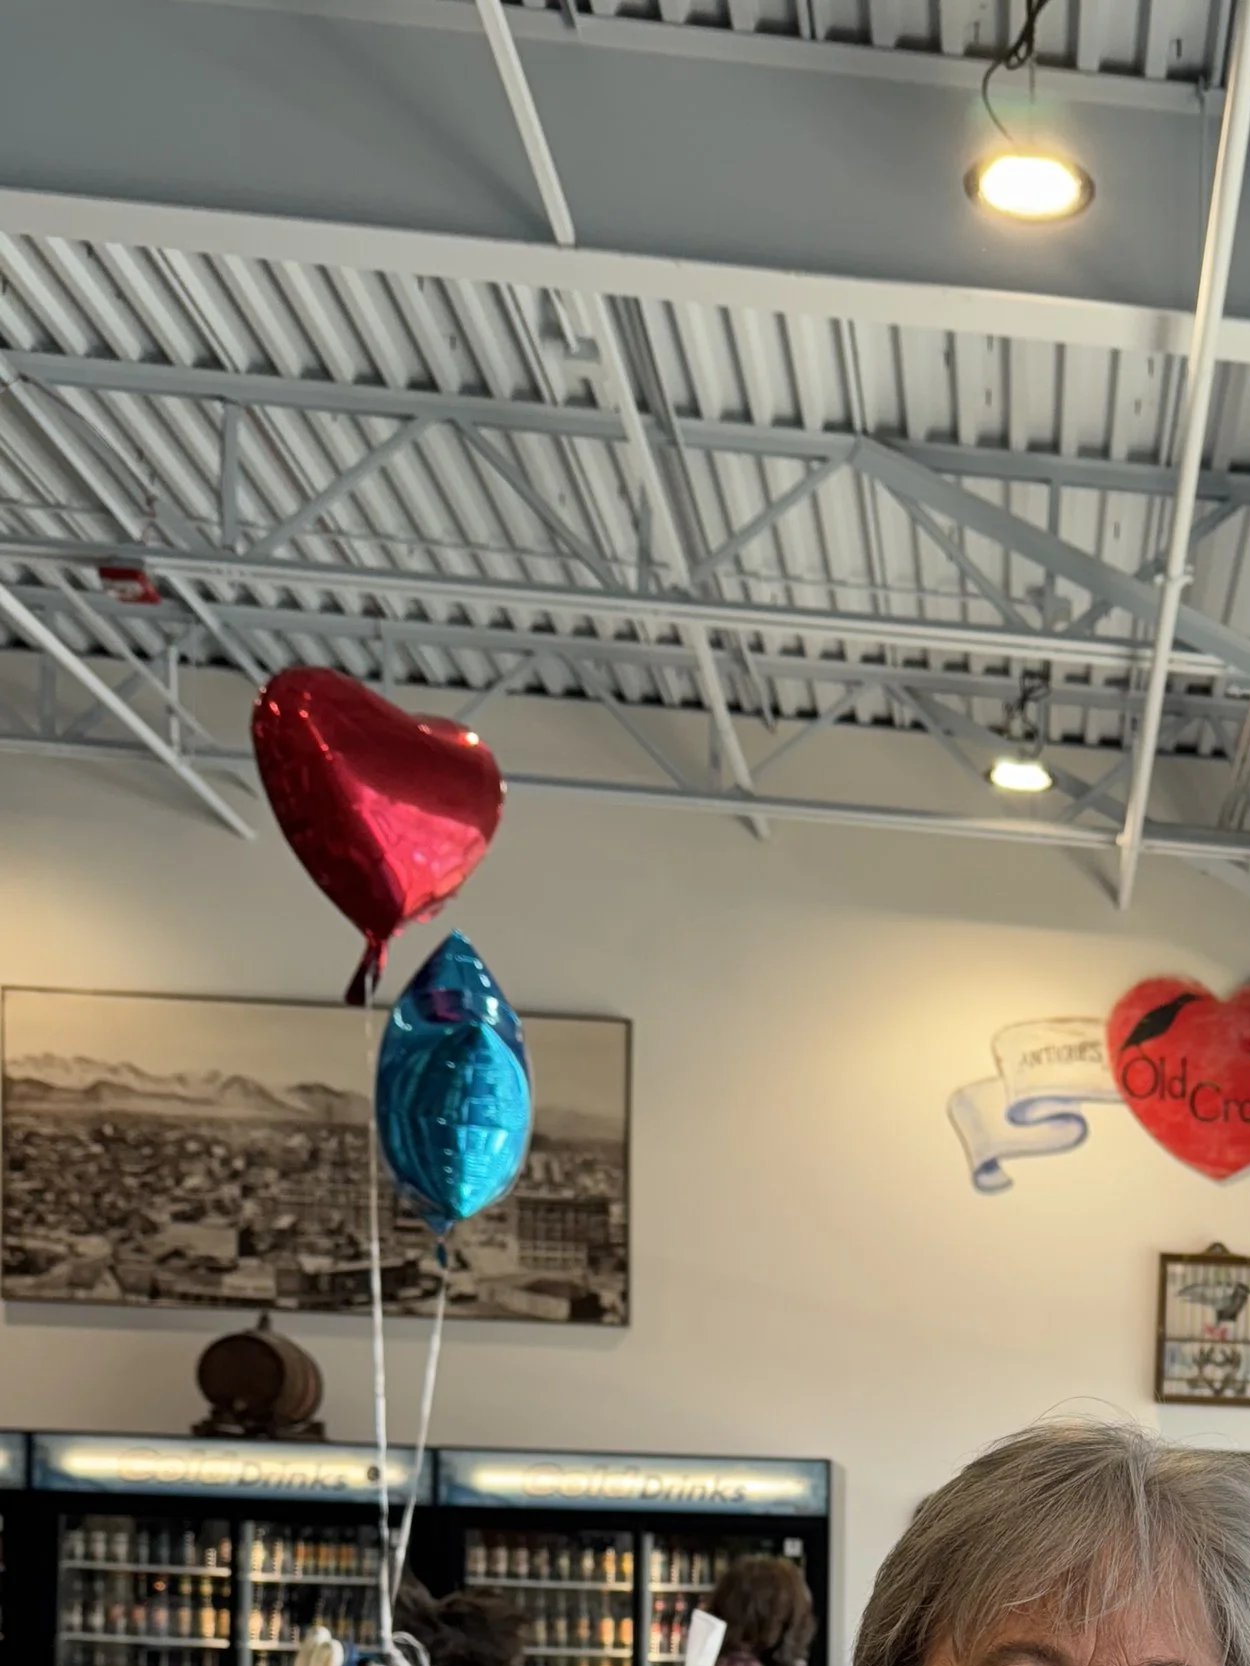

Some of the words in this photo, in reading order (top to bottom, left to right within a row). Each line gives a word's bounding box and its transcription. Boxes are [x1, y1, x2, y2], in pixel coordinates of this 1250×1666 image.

[1121, 1055, 1187, 1100] Old
[118, 1446, 239, 1485] Cold
[238, 1459, 348, 1492] Drinks
[522, 1462, 641, 1499] Cold
[638, 1474, 747, 1503] Drinks
